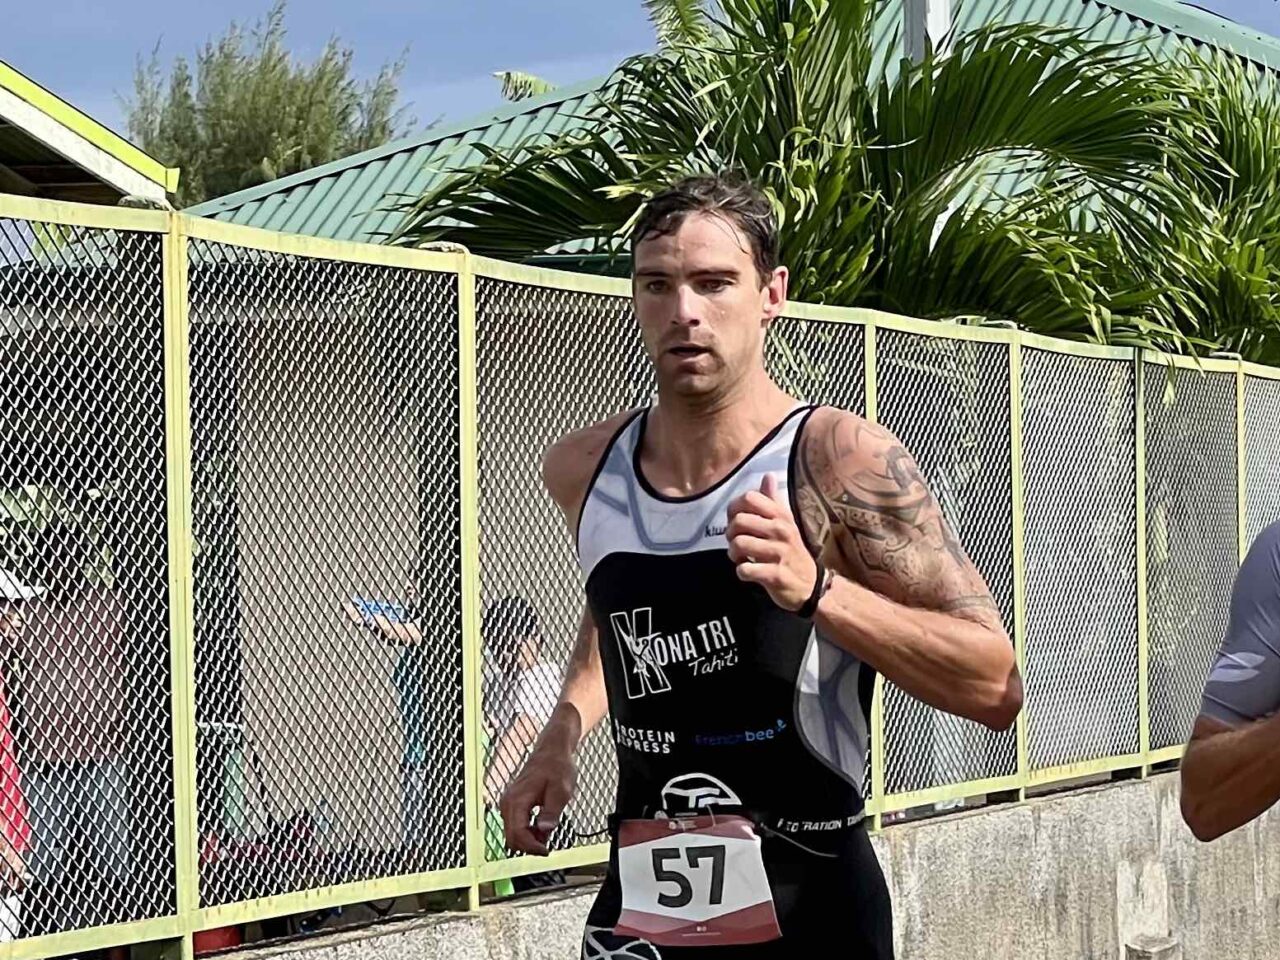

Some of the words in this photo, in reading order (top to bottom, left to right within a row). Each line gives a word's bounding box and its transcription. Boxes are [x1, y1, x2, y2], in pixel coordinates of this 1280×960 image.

[697, 616, 736, 653] TRI
[688, 648, 738, 676] Tahiti
[651, 845, 726, 908] 57
